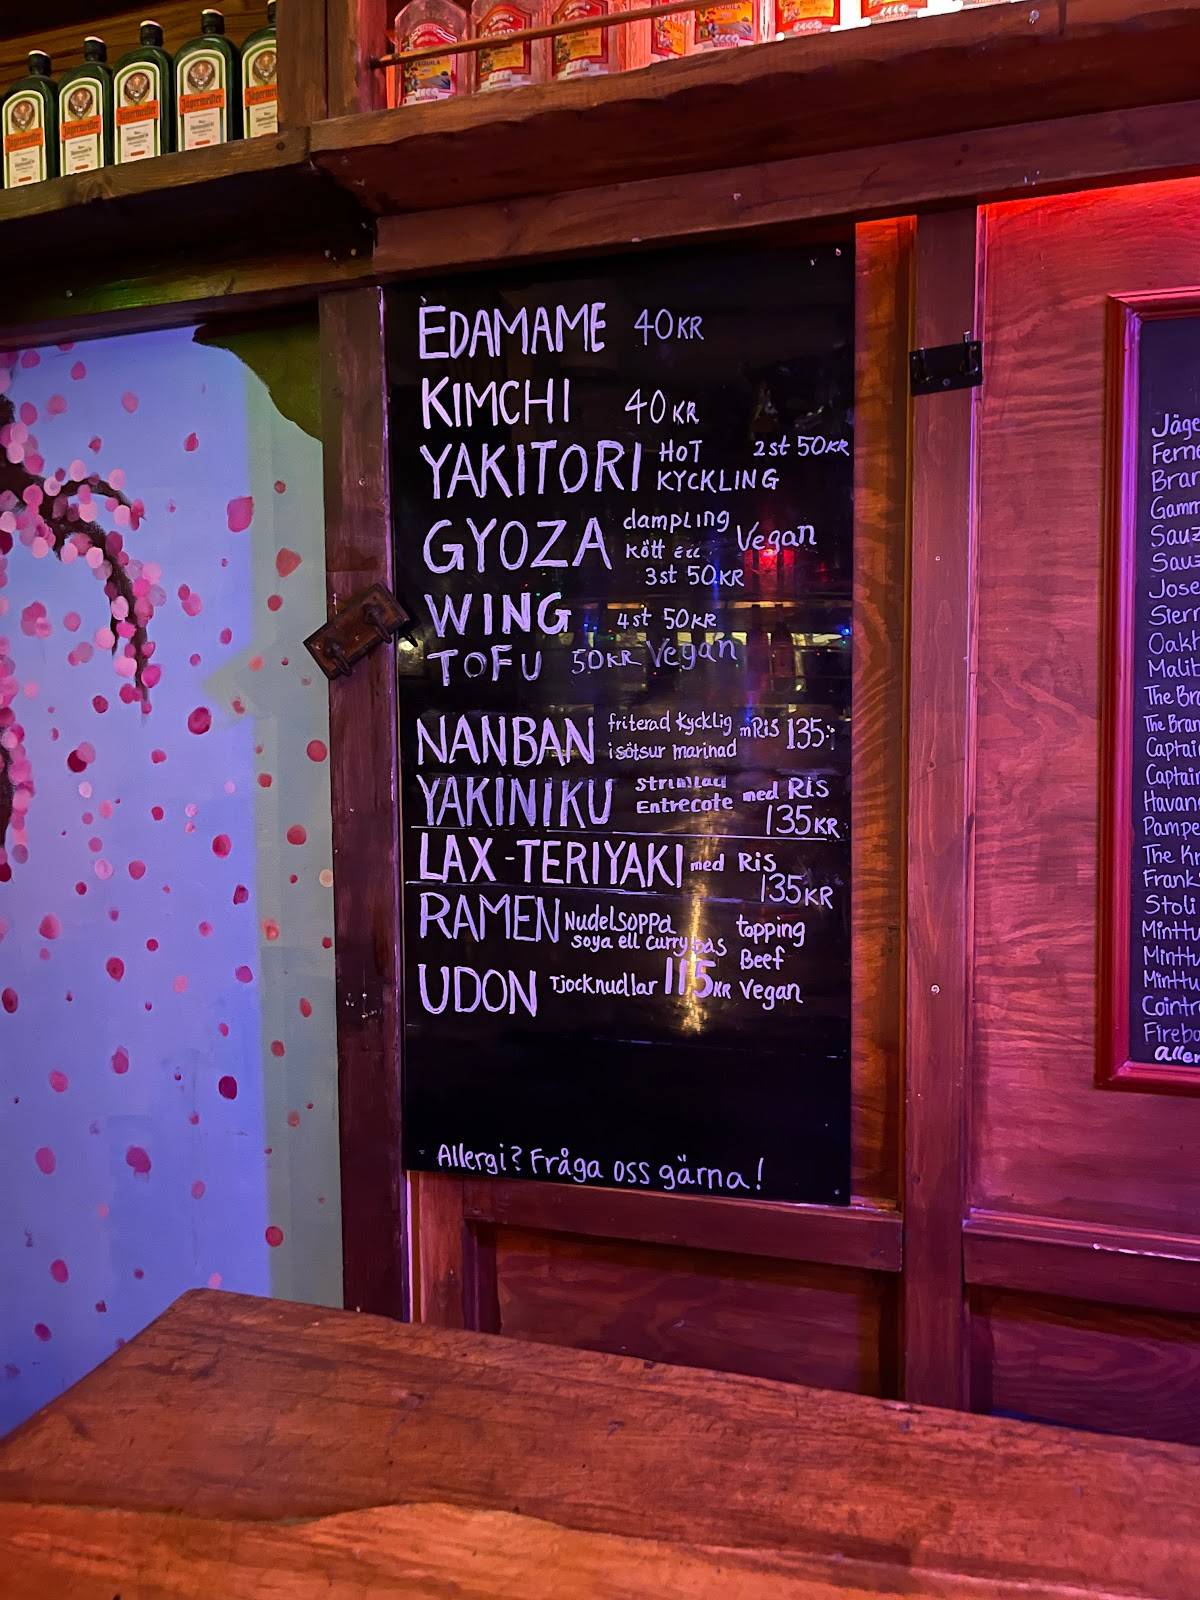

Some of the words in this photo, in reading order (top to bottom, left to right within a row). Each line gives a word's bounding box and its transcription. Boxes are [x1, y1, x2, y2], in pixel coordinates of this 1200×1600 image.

[419, 302, 606, 359] EDAMAME
[422, 376, 570, 429] KIMCHI
[419, 440, 641, 499] YAKITORI
[657, 468, 779, 492] KYCKLING
[423, 517, 613, 573] GYOZA
[736, 522, 817, 556] Vegan
[1149, 578, 1200, 598] Jose
[424, 592, 572, 637] WING
[427, 645, 542, 686] TOFU
[646, 637, 738, 670] Vegan
[1144, 685, 1174, 705] The
[1143, 714, 1166, 732] The
[417, 715, 596, 767] NANBAN
[671, 739, 737, 760] marinad
[1146, 737, 1200, 761] Captai
[416, 774, 613, 828] YAKINIKU
[742, 781, 779, 802] med
[1144, 790, 1200, 812] Havan
[690, 853, 725, 872] med
[1142, 844, 1175, 864] The
[1144, 895, 1196, 915] Stoli
[419, 892, 560, 943] RAMEN
[736, 916, 805, 947] topping
[739, 945, 786, 971] Beef
[418, 963, 538, 1017] UDON
[738, 980, 803, 1010] Vegan
[1144, 970, 1200, 991] Minttu
[1142, 995, 1200, 1016] Cointr
[437, 1143, 523, 1175] Allergi?
[530, 1148, 603, 1183] Fråga
[613, 1160, 650, 1184] oss
